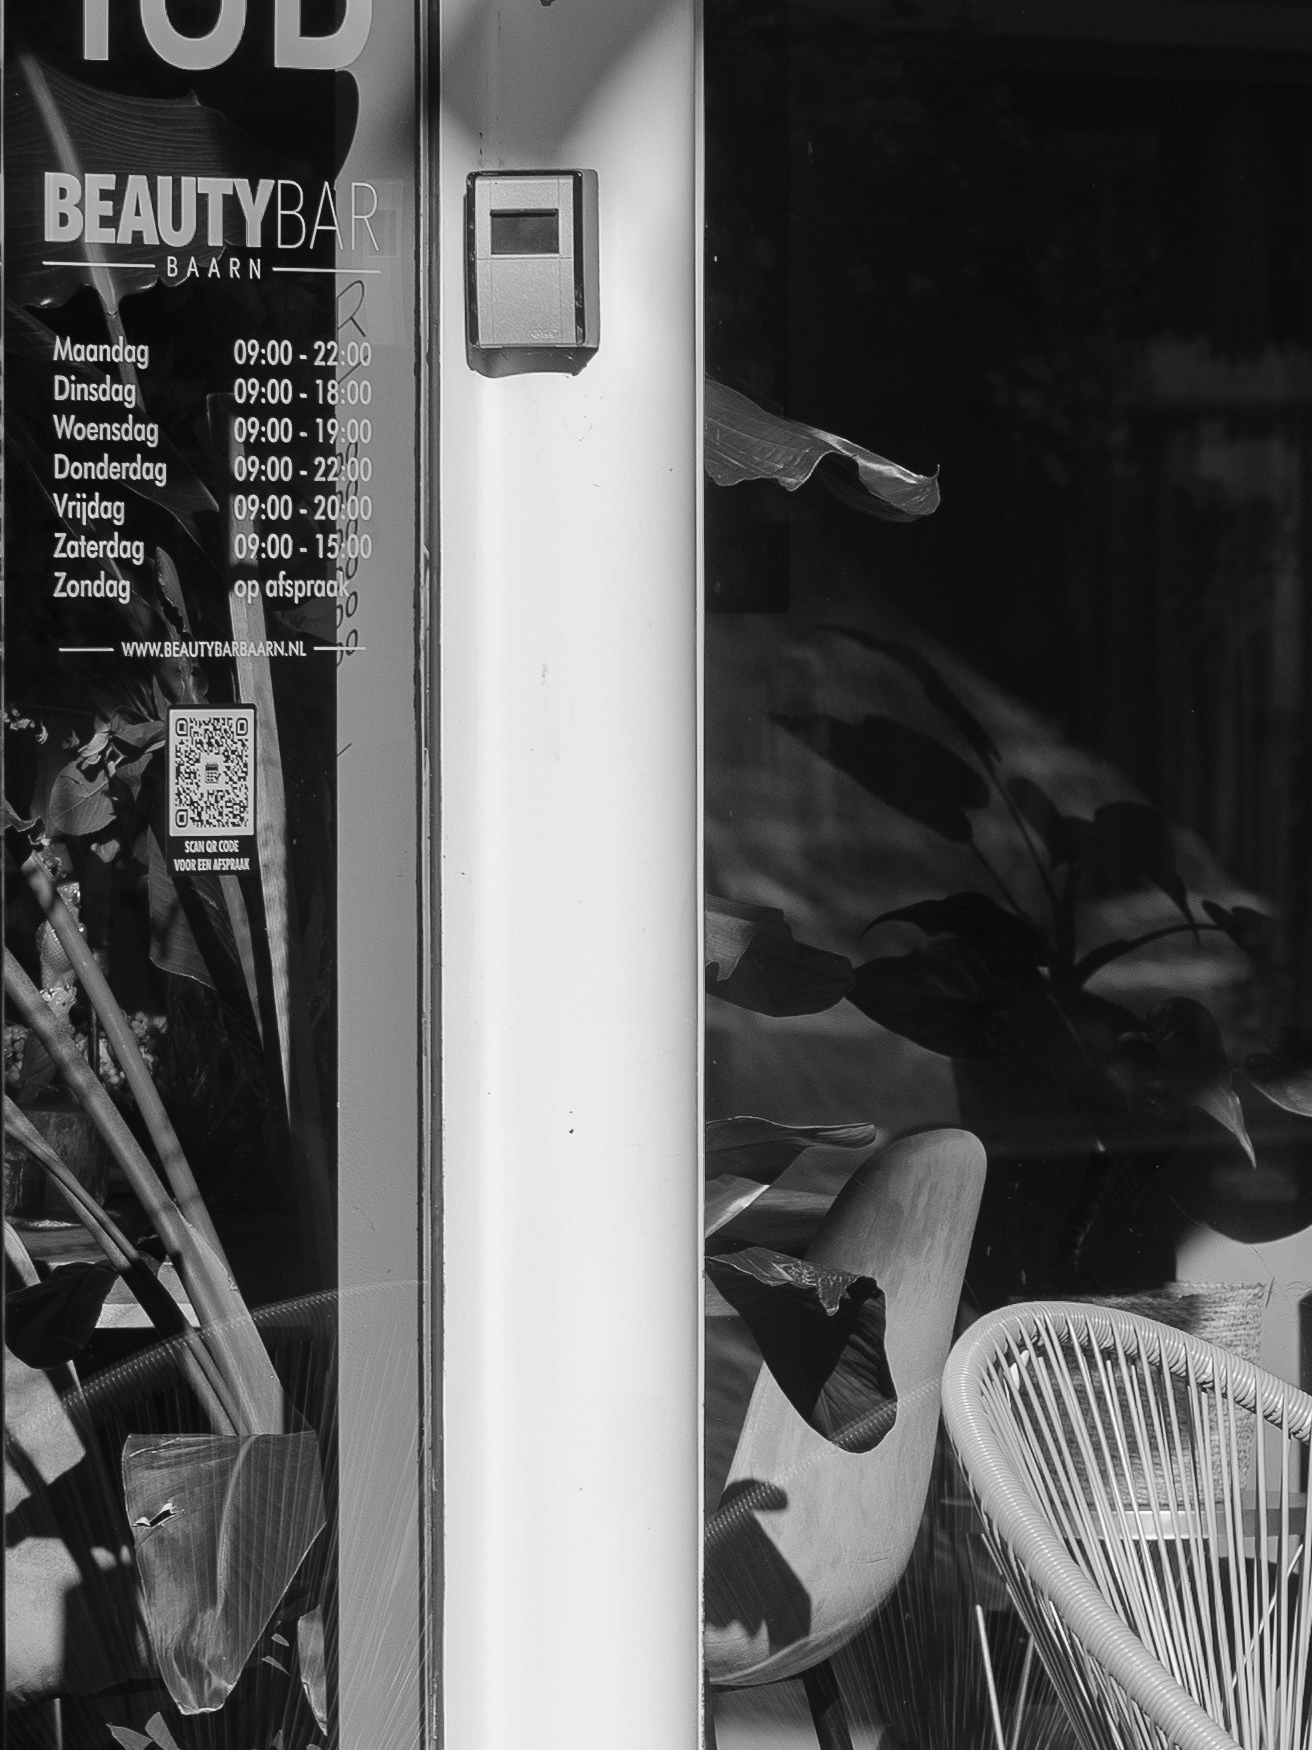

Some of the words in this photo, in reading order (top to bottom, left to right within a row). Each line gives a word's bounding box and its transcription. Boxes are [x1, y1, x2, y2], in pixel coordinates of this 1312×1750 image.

[44, 171, 381, 251] BEAUTYBAR
[166, 255, 263, 280] BAARN
[53, 336, 149, 368] Maandag
[233, 339, 294, 366] 09:00
[313, 339, 373, 366] 22:00
[53, 375, 137, 407] Dinsdag
[233, 379, 294, 404] 09:00
[313, 379, 373, 404] 18:00
[53, 414, 160, 446] Woensdag
[233, 417, 294, 444] 09:00
[313, 417, 373, 444] 19:00
[53, 453, 168, 485] Donderdag
[233, 457, 294, 483] 09:00
[313, 457, 373, 483] 22:00
[53, 493, 127, 525] Vrijdag
[233, 496, 294, 521] 09:00
[313, 496, 373, 521] 20:00
[53, 531, 146, 564] Zaterdag
[233, 534, 294, 560] 09:00
[313, 534, 373, 560] 15:00
[53, 571, 132, 604] Zondag
[234, 578, 260, 604] op
[265, 570, 350, 603] afspraak
[121, 640, 307, 658] WWW.BEAUTYBARBAARN.NL
[184, 840, 205, 853] SCAN
[205, 840, 218, 853] QR
[218, 839, 240, 853] CODE
[173, 858, 197, 871] VOOR
[197, 858, 212, 871] EEN
[212, 857, 251, 871] AFSPRAAK
